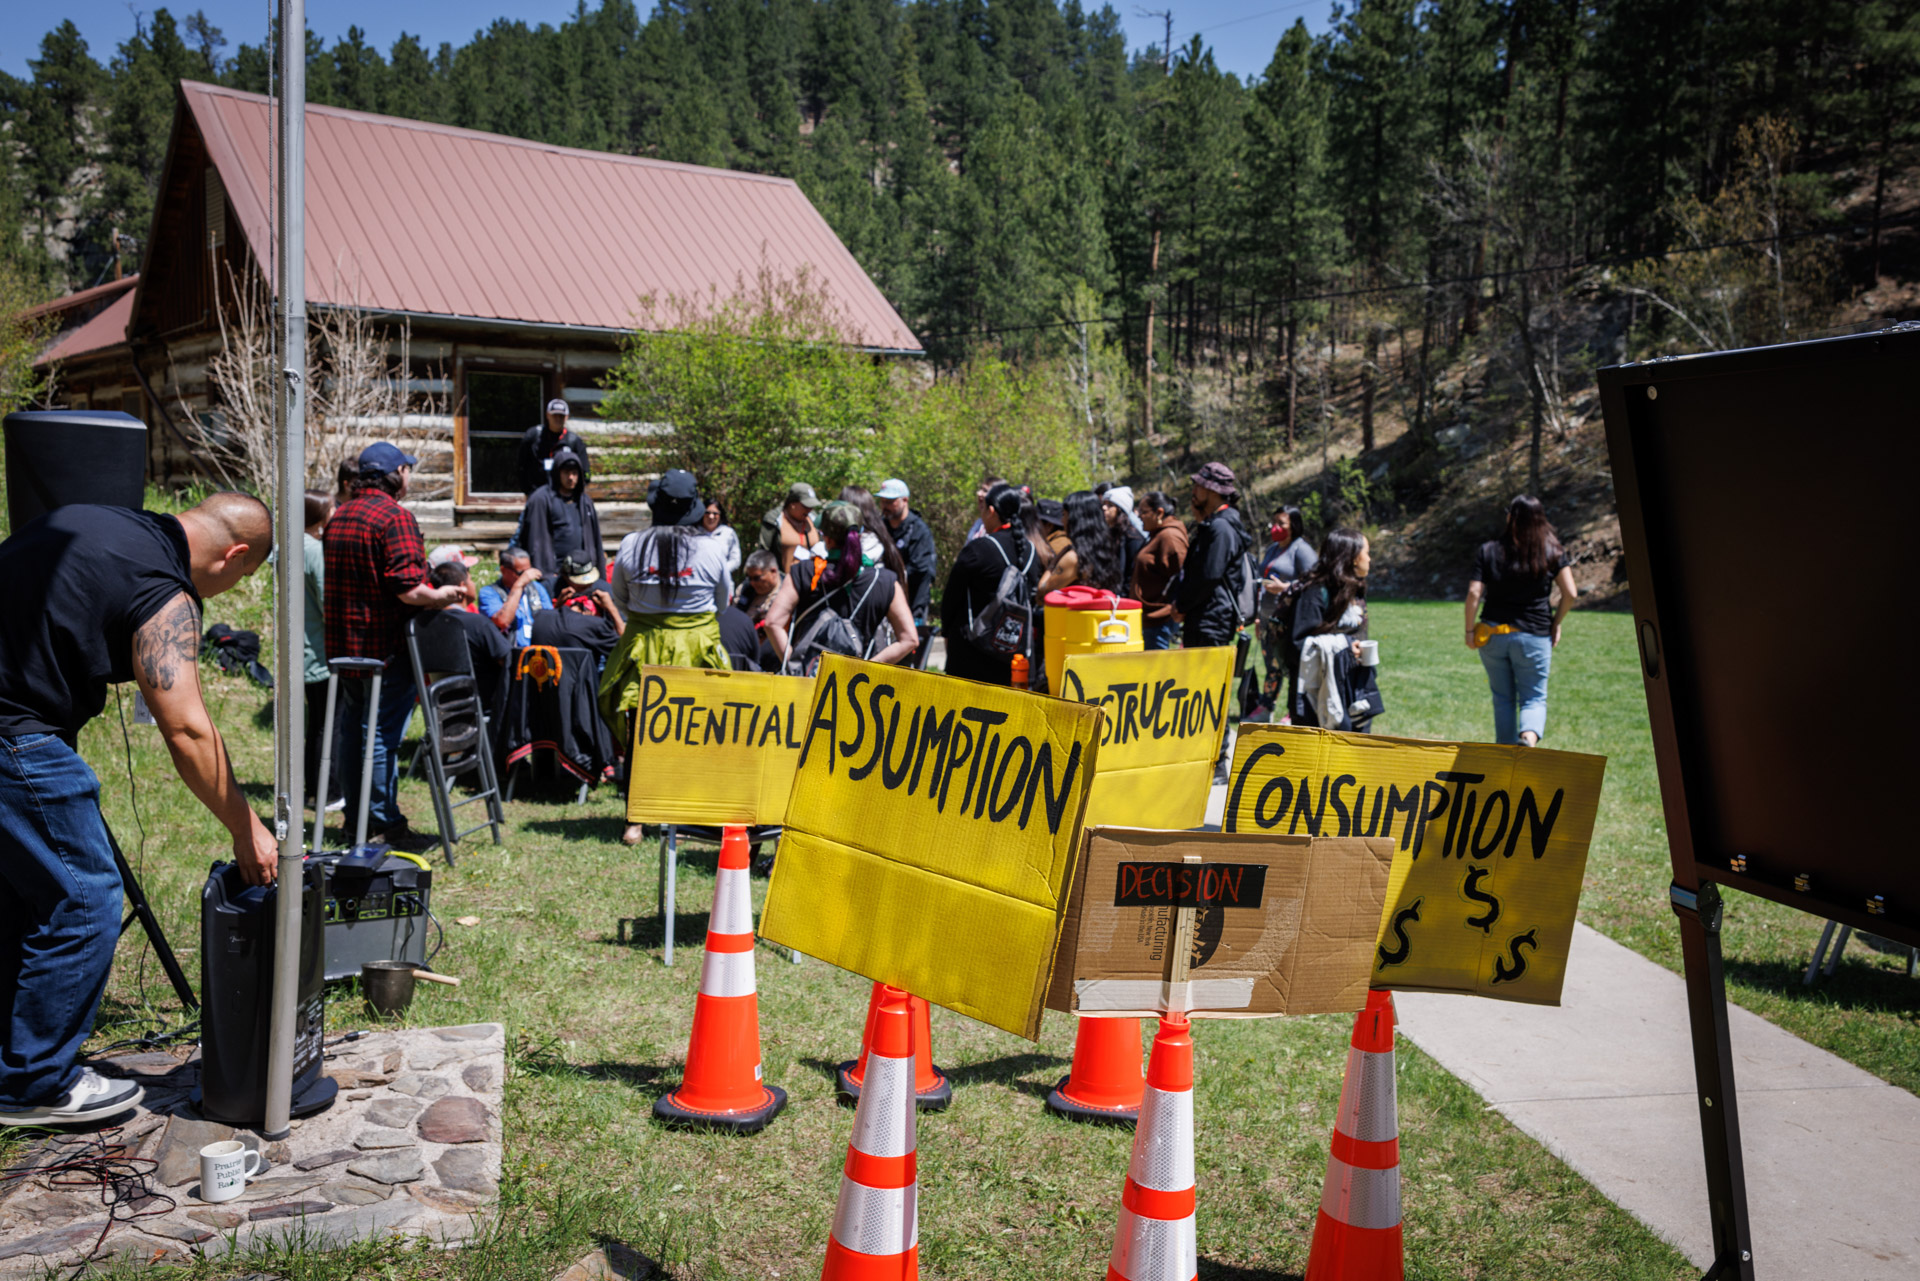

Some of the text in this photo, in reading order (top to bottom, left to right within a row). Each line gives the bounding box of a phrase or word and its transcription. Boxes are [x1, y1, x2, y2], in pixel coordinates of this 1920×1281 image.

[639, 675, 802, 749] POTENTIAL
[1063, 669, 1226, 747] STRUCTION
[800, 671, 1083, 835] ASSUMPTION
[1225, 742, 1565, 860] CONSUMPTION
[1121, 864, 1244, 903] DECISION
[1149, 906, 1170, 961] nufacturing
